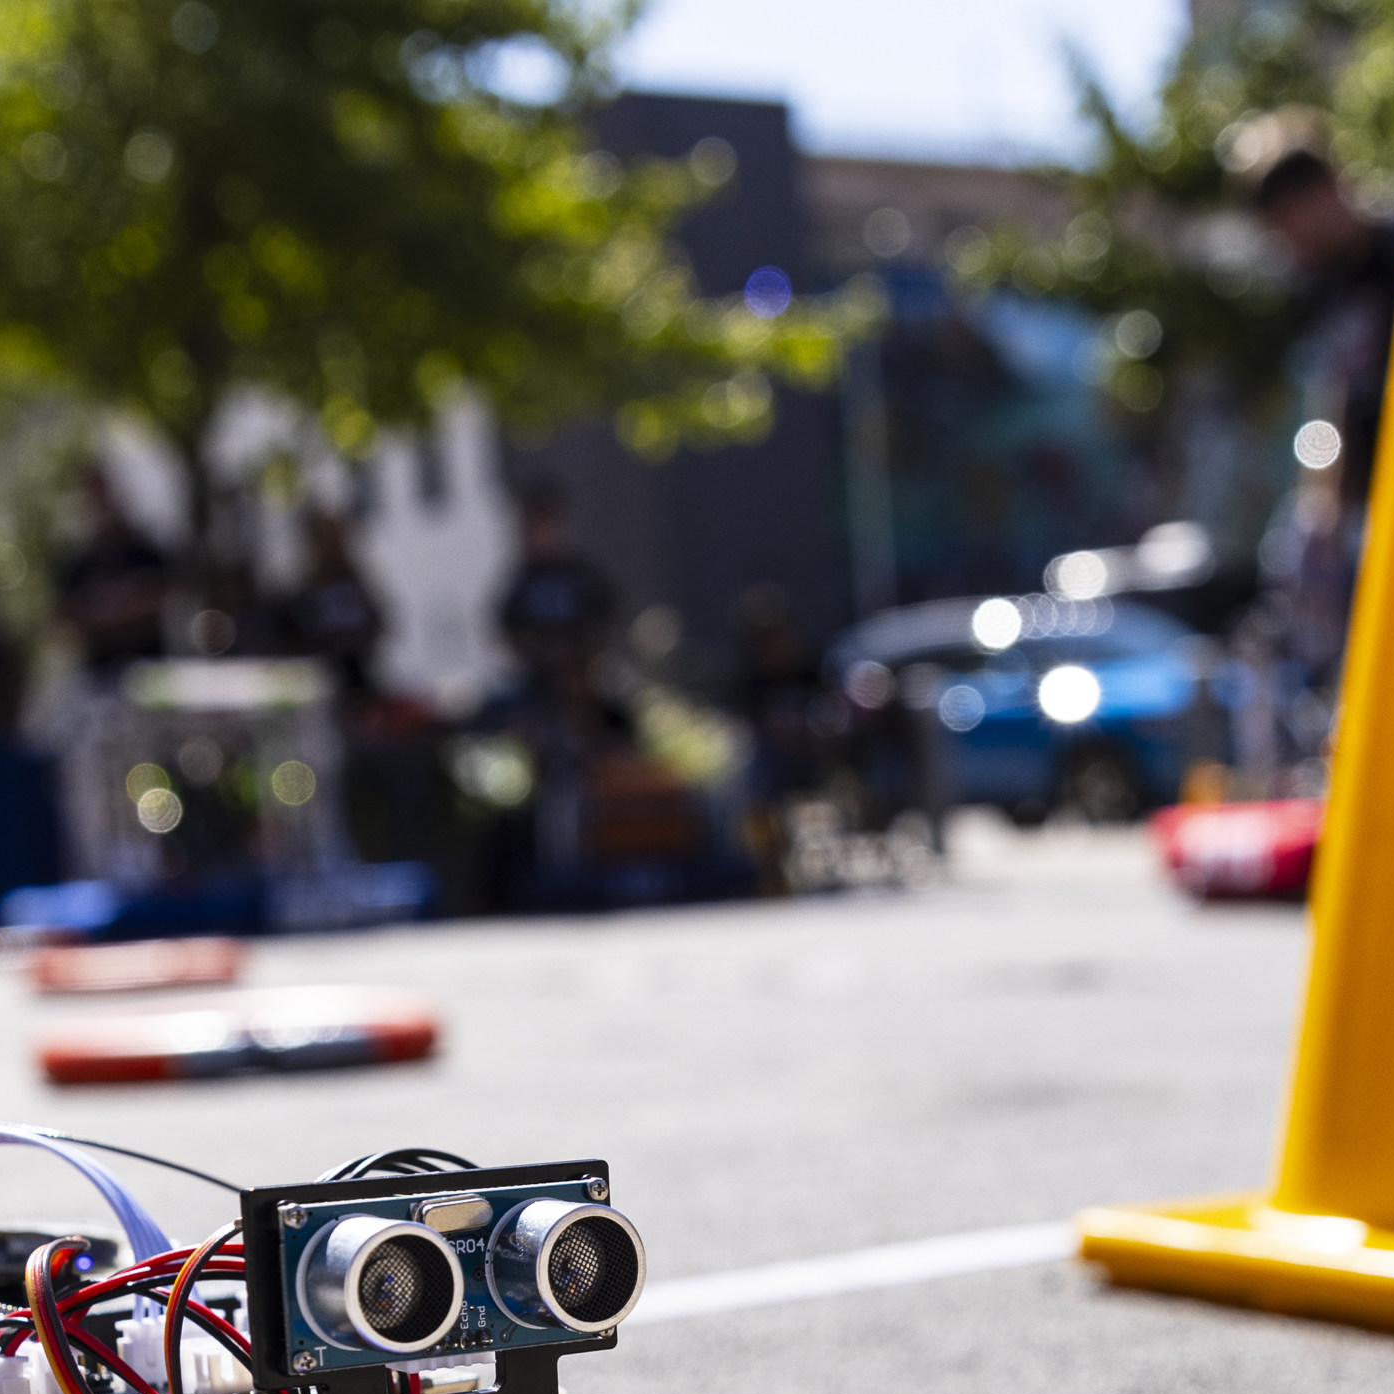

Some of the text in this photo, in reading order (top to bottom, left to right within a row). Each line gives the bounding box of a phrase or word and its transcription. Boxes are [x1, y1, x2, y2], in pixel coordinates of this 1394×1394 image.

[460, 1300, 469, 1330] Echo
[477, 1305, 486, 1328] Gnd
[314, 1346, 327, 1367] T
